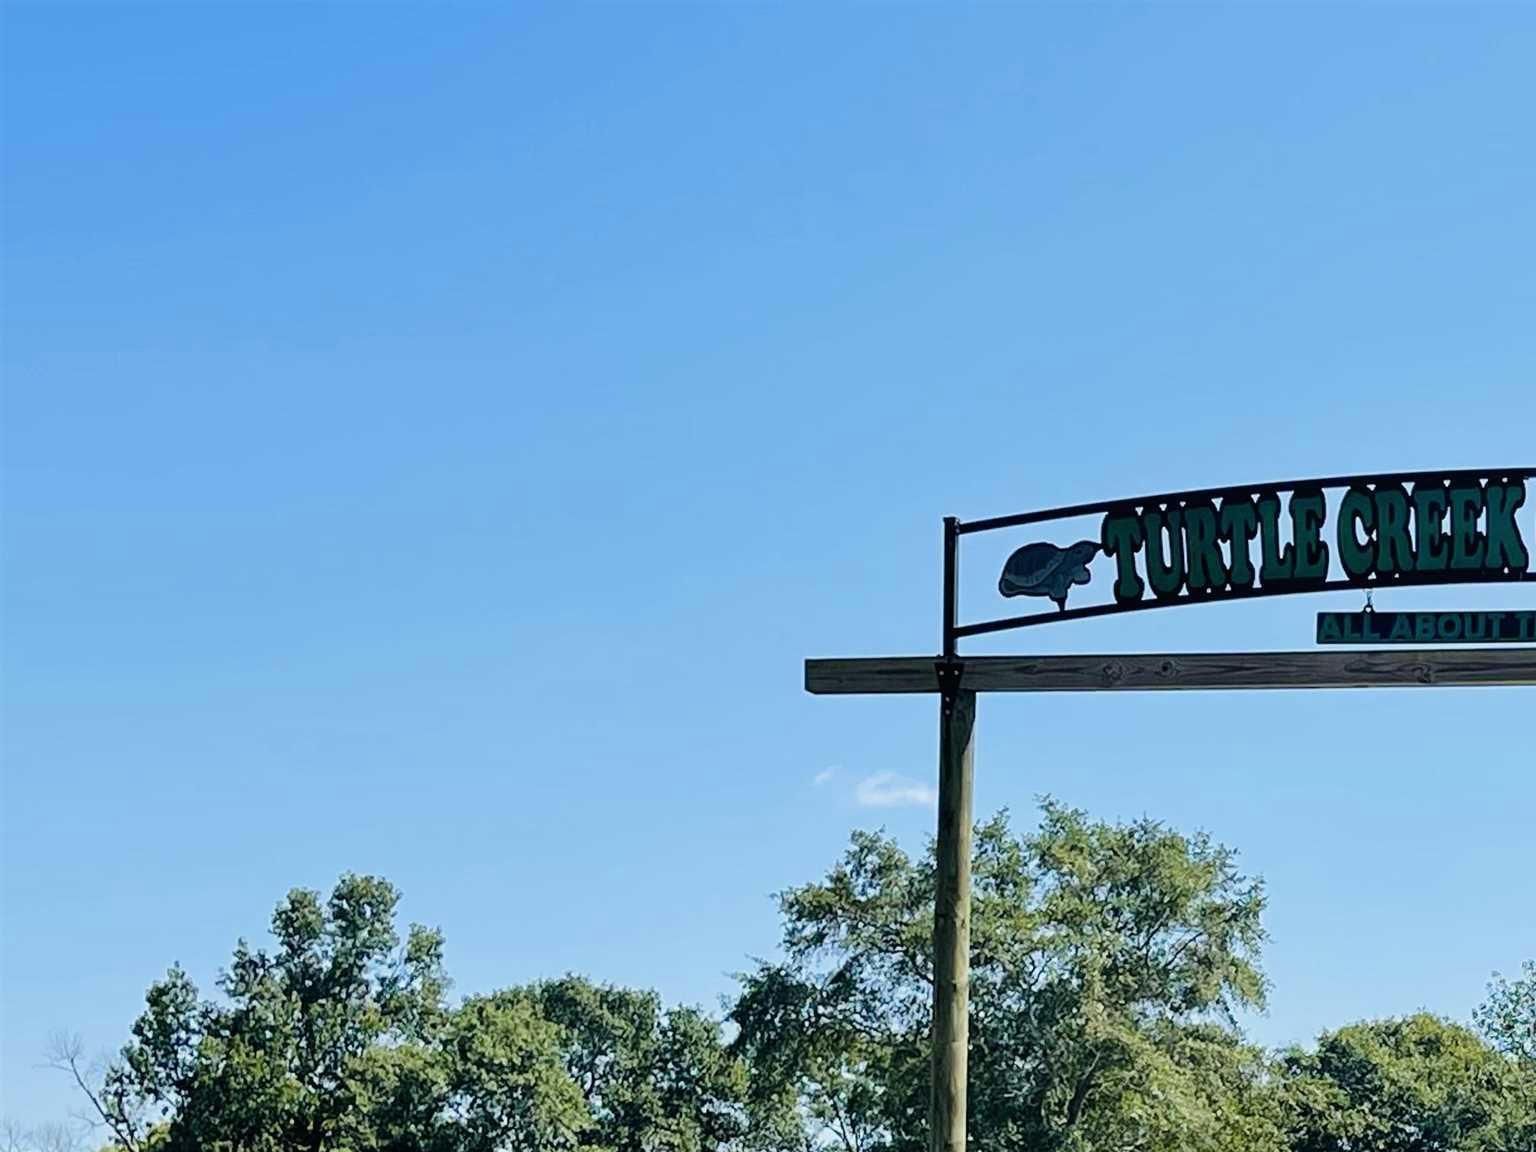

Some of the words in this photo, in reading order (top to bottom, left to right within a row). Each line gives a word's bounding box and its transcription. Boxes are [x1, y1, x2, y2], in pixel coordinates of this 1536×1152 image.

[1103, 489, 1326, 602] TURTLE
[1339, 482, 1528, 576] CREEK
[1319, 614, 1382, 640] ALL
[1390, 613, 1507, 641] ABOUT
